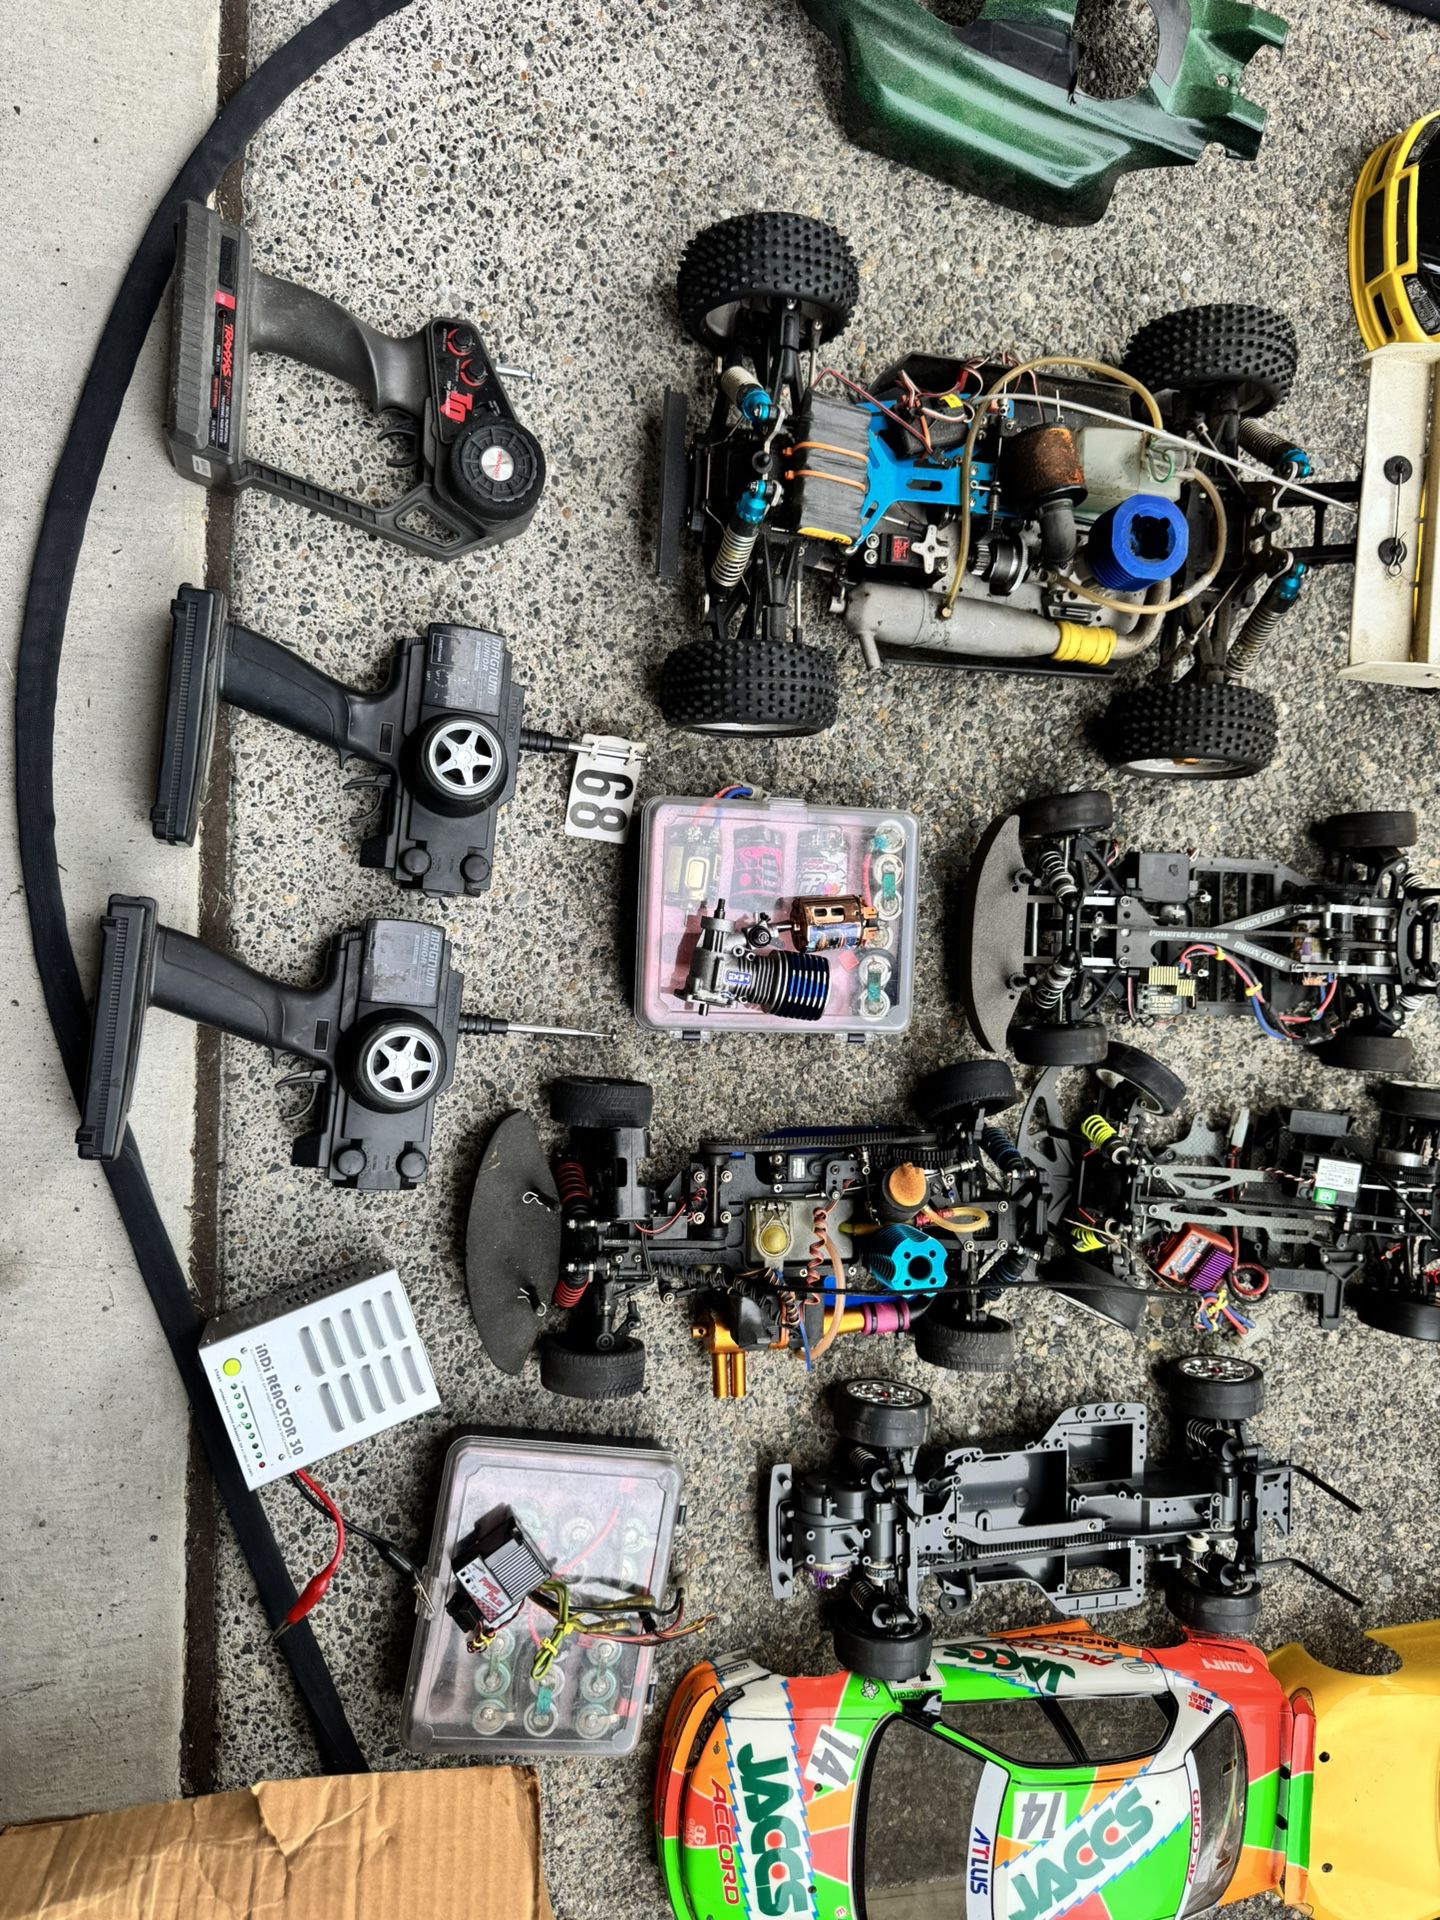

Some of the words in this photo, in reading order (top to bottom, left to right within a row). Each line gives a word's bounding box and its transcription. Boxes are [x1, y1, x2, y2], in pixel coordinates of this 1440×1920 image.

[223, 324, 233, 376] TRAXXAS
[438, 391, 473, 422] TQ
[482, 637, 490, 671] JUNIOR
[487, 638, 501, 695] MAGNUM
[569, 769, 633, 832] 68
[1149, 930, 1188, 938] Powered
[1234, 917, 1260, 930] ORION
[1262, 908, 1286, 923] CELLS
[420, 929, 430, 964] JUNIOR
[425, 931, 440, 987] MAGNUM
[1234, 941, 1260, 957] ORION
[1261, 951, 1286, 967] CELLS
[266, 1374, 298, 1437] REACTOR
[289, 1439, 305, 1456] 30
[943, 1646, 1075, 1694] JACCS
[1187, 1695, 1213, 1710] TOTAL
[810, 1728, 859, 1786] 14
[711, 1779, 740, 1905] ACCORD
[736, 1743, 809, 1916] JACCS
[1018, 1792, 1062, 1839] 14
[1186, 1789, 1201, 1885] ACCORD
[970, 1827, 991, 1895] ATLUS
[1009, 1786, 1154, 1920] JACCS
